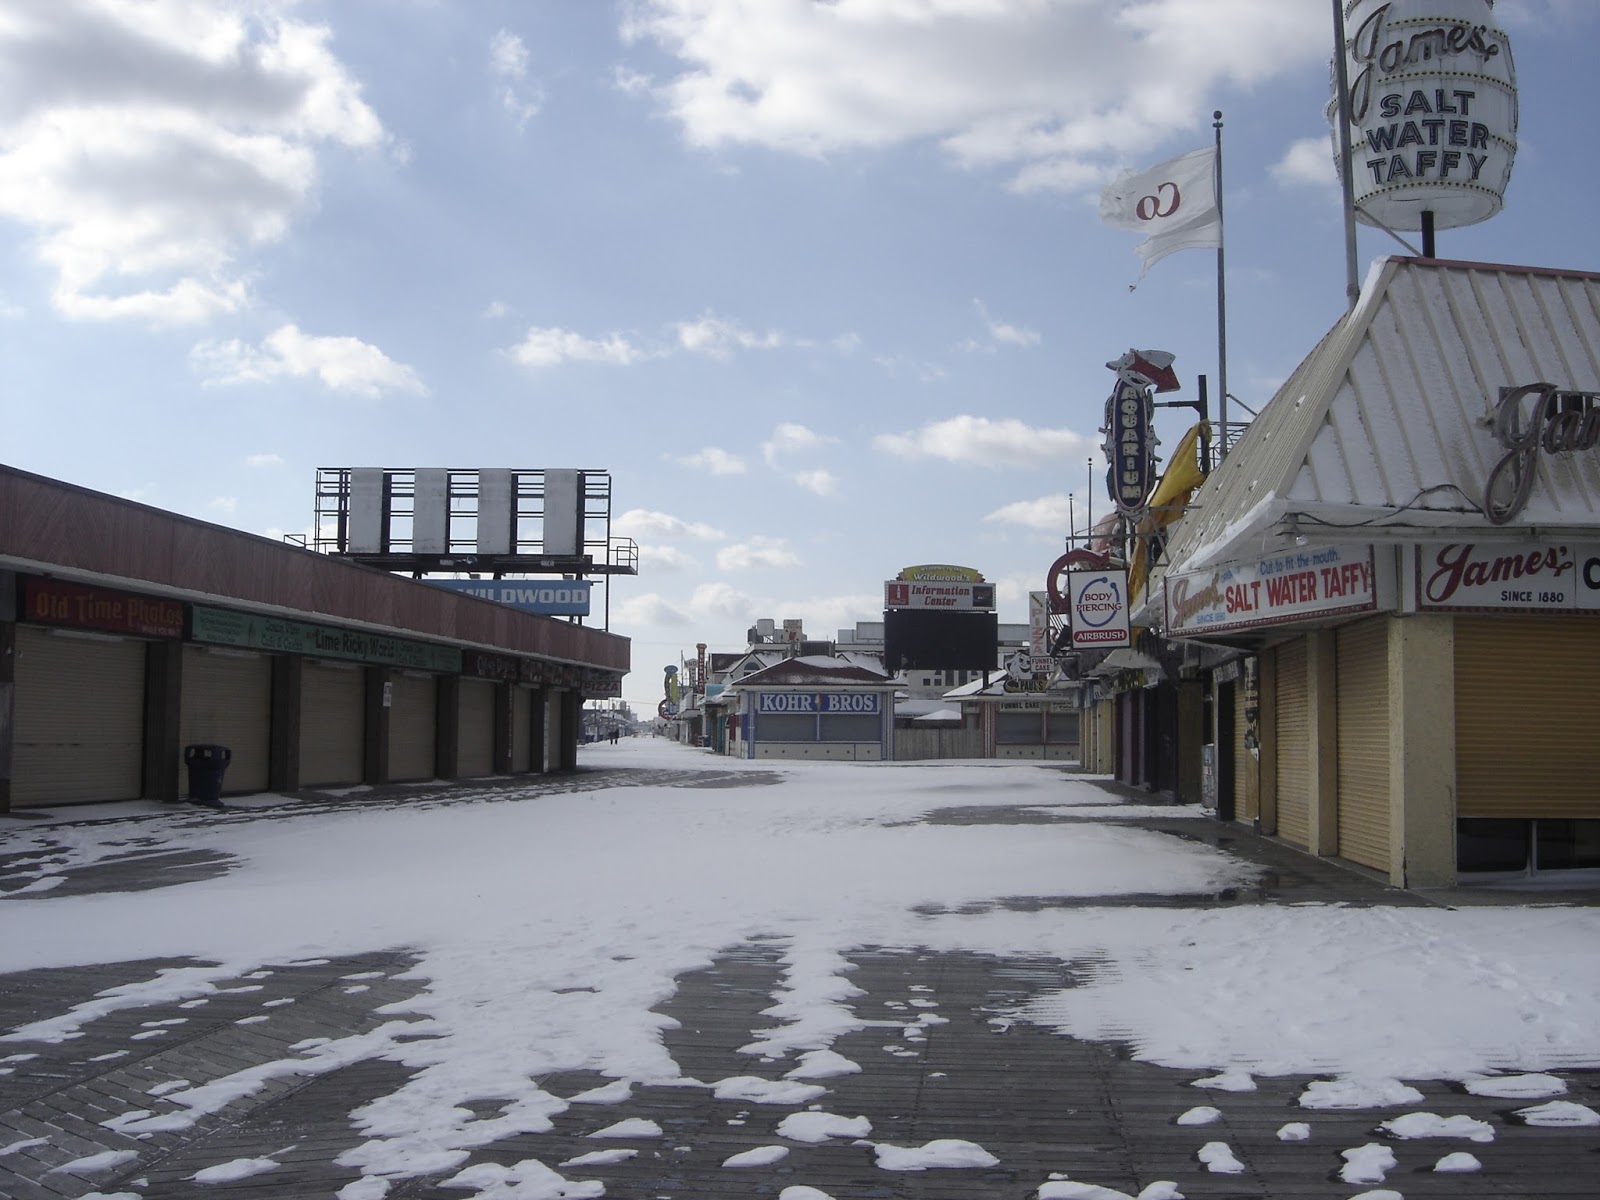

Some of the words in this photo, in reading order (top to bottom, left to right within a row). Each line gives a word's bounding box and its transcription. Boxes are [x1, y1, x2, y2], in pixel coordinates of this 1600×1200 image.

[1380, 89, 1475, 118] SALT
[1366, 119, 1489, 153] WATER
[1366, 150, 1488, 185] TAFFY
[1121, 386, 1141, 499] AQUARIUM
[914, 573, 970, 582] Wildwood's
[911, 585, 970, 596] Information
[1225, 581, 1261, 614] SALT
[1266, 571, 1317, 607] WATER
[1321, 562, 1369, 598] TAFFY
[924, 596, 957, 607] Center
[1085, 593, 1112, 601] BODY
[1501, 591, 1532, 602] SINCE
[1538, 592, 1564, 603] 1880
[36, 591, 68, 619] Old
[75, 592, 123, 621] Time
[127, 598, 184, 627] Photos
[1076, 602, 1122, 612] PIERCING
[1032, 609, 1044, 654] PIZZA
[1077, 631, 1125, 641] AIRBRUSH
[315, 629, 339, 651] Lime
[343, 632, 368, 660] Ricky
[584, 682, 619, 691] PIZZA
[1020, 680, 1043, 691] PAUL'S
[762, 694, 812, 711] KOHR
[828, 694, 874, 711] BROS
